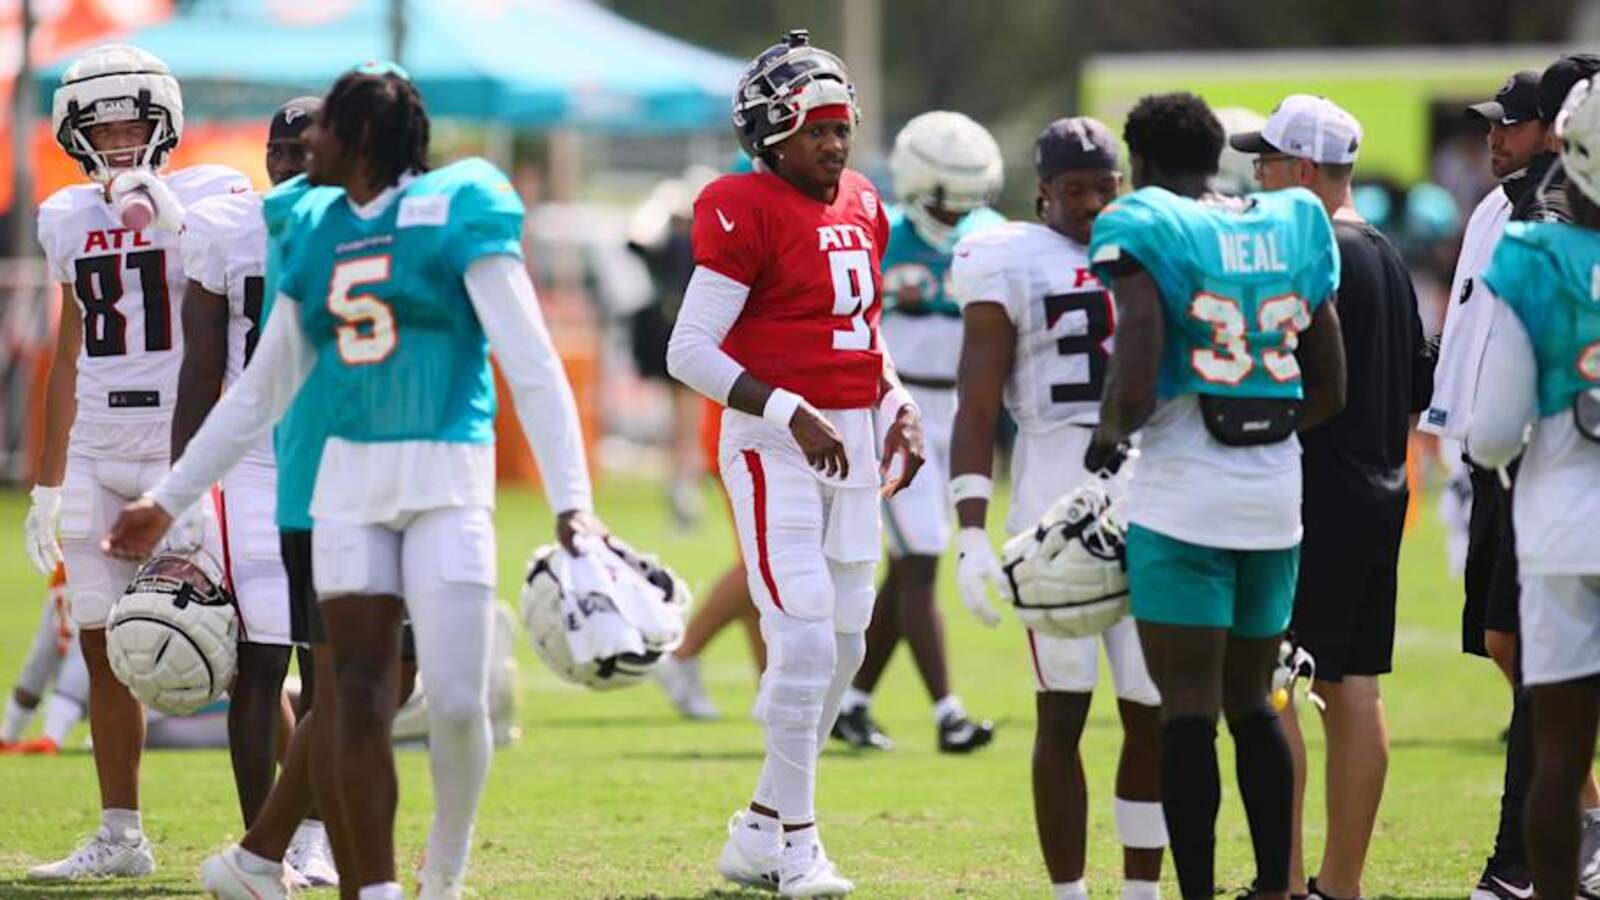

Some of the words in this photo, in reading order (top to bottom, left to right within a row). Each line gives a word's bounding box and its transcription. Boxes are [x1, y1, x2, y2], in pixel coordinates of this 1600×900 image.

[85, 228, 150, 252] ATL
[816, 224, 873, 251] ATL
[1218, 231, 1289, 273] NEAL
[75, 249, 170, 357] 81
[328, 254, 397, 365] 5
[827, 248, 875, 350] 9
